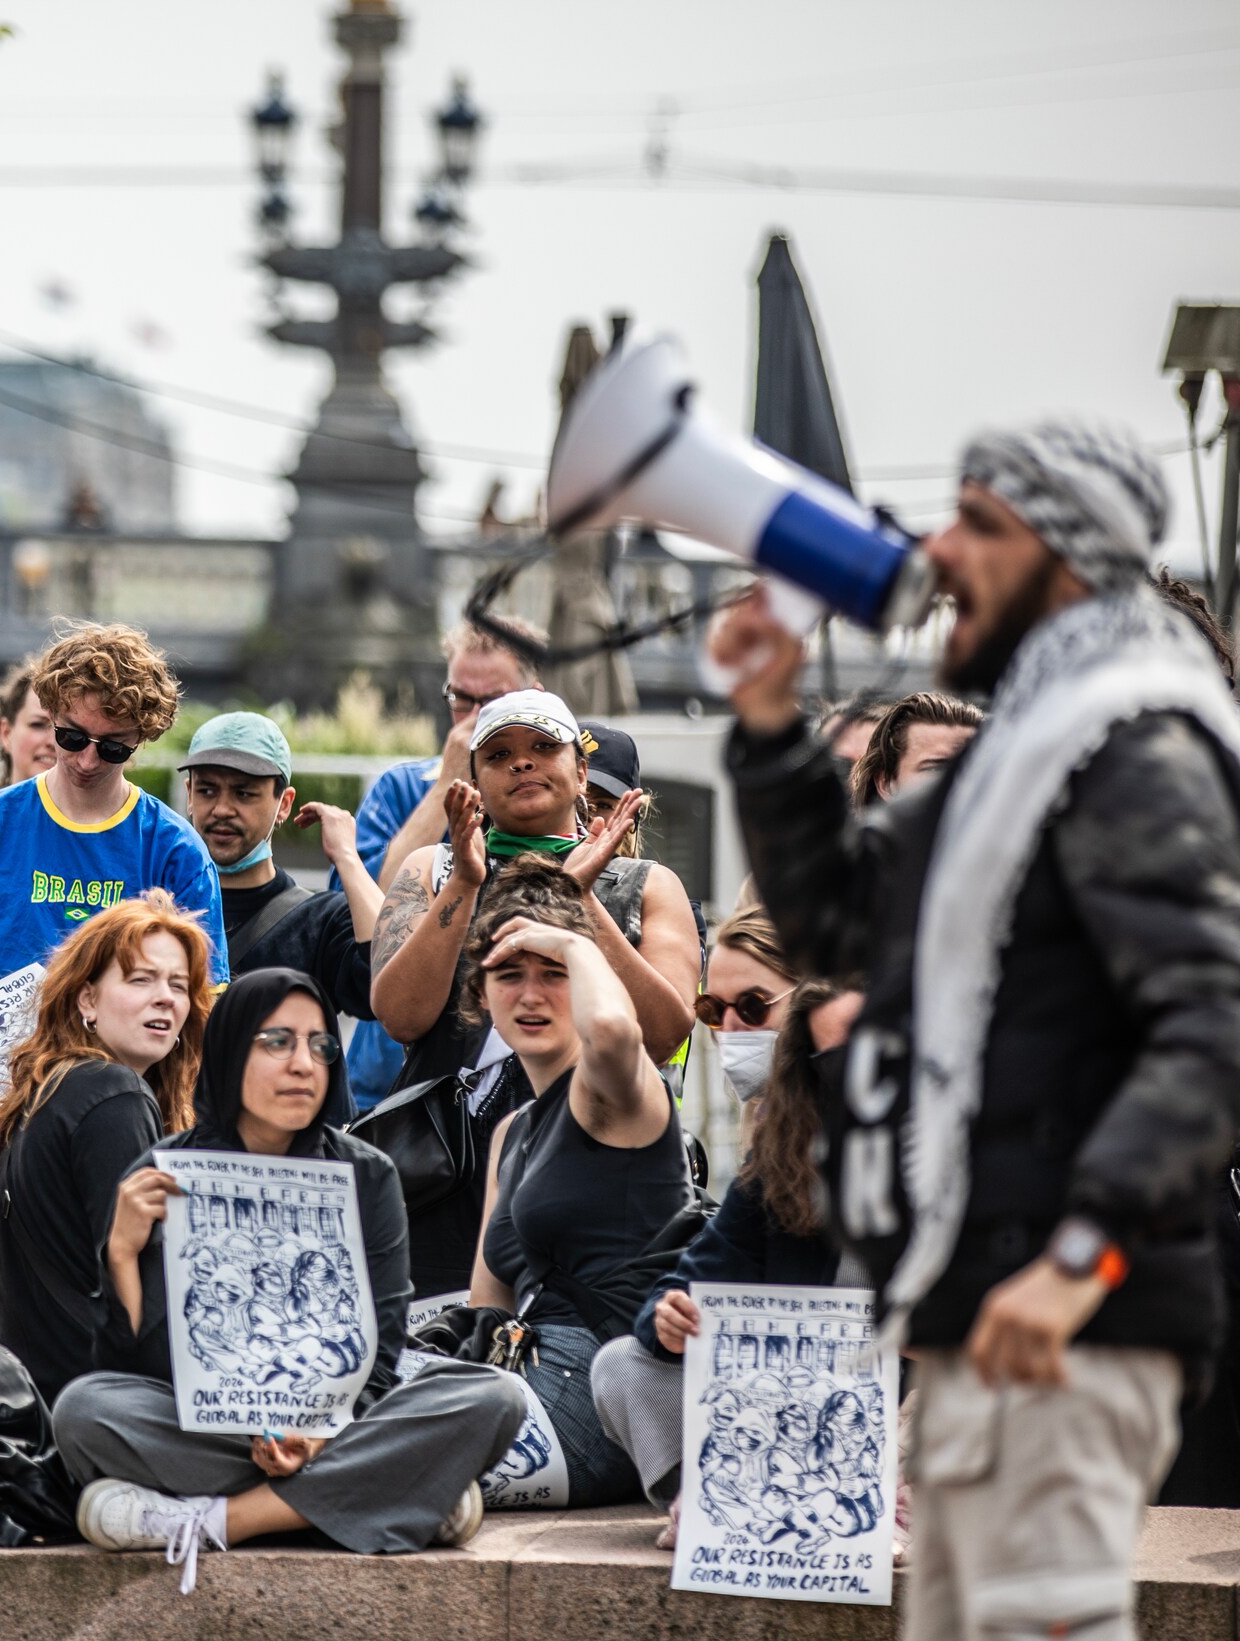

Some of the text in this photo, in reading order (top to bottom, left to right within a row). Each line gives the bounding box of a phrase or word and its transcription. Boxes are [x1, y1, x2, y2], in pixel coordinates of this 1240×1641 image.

[31, 870, 126, 908] BRASIL
[0, 972, 35, 992] GLOBAL
[169, 1160, 192, 1171] FROM
[194, 1160, 207, 1171] THE
[320, 1173, 330, 1186] BE
[332, 1174, 349, 1186] FREE
[701, 1294, 724, 1308] FROM
[727, 1295, 740, 1307] THE
[219, 1376, 245, 1388] 2024
[193, 1389, 222, 1407] OUR
[228, 1390, 322, 1409] RESISTANCE
[323, 1394, 335, 1408] IS
[196, 1409, 244, 1425] GLOBAL
[247, 1410, 262, 1426] AS
[267, 1411, 294, 1427] YOUR
[534, 1487, 551, 1499] AS
[722, 1531, 751, 1545] 2024
[691, 1546, 872, 1570] OUR RESISTANCE IS AS
[689, 1566, 870, 1594] GLOBAL AS YOUR CAPITAL
